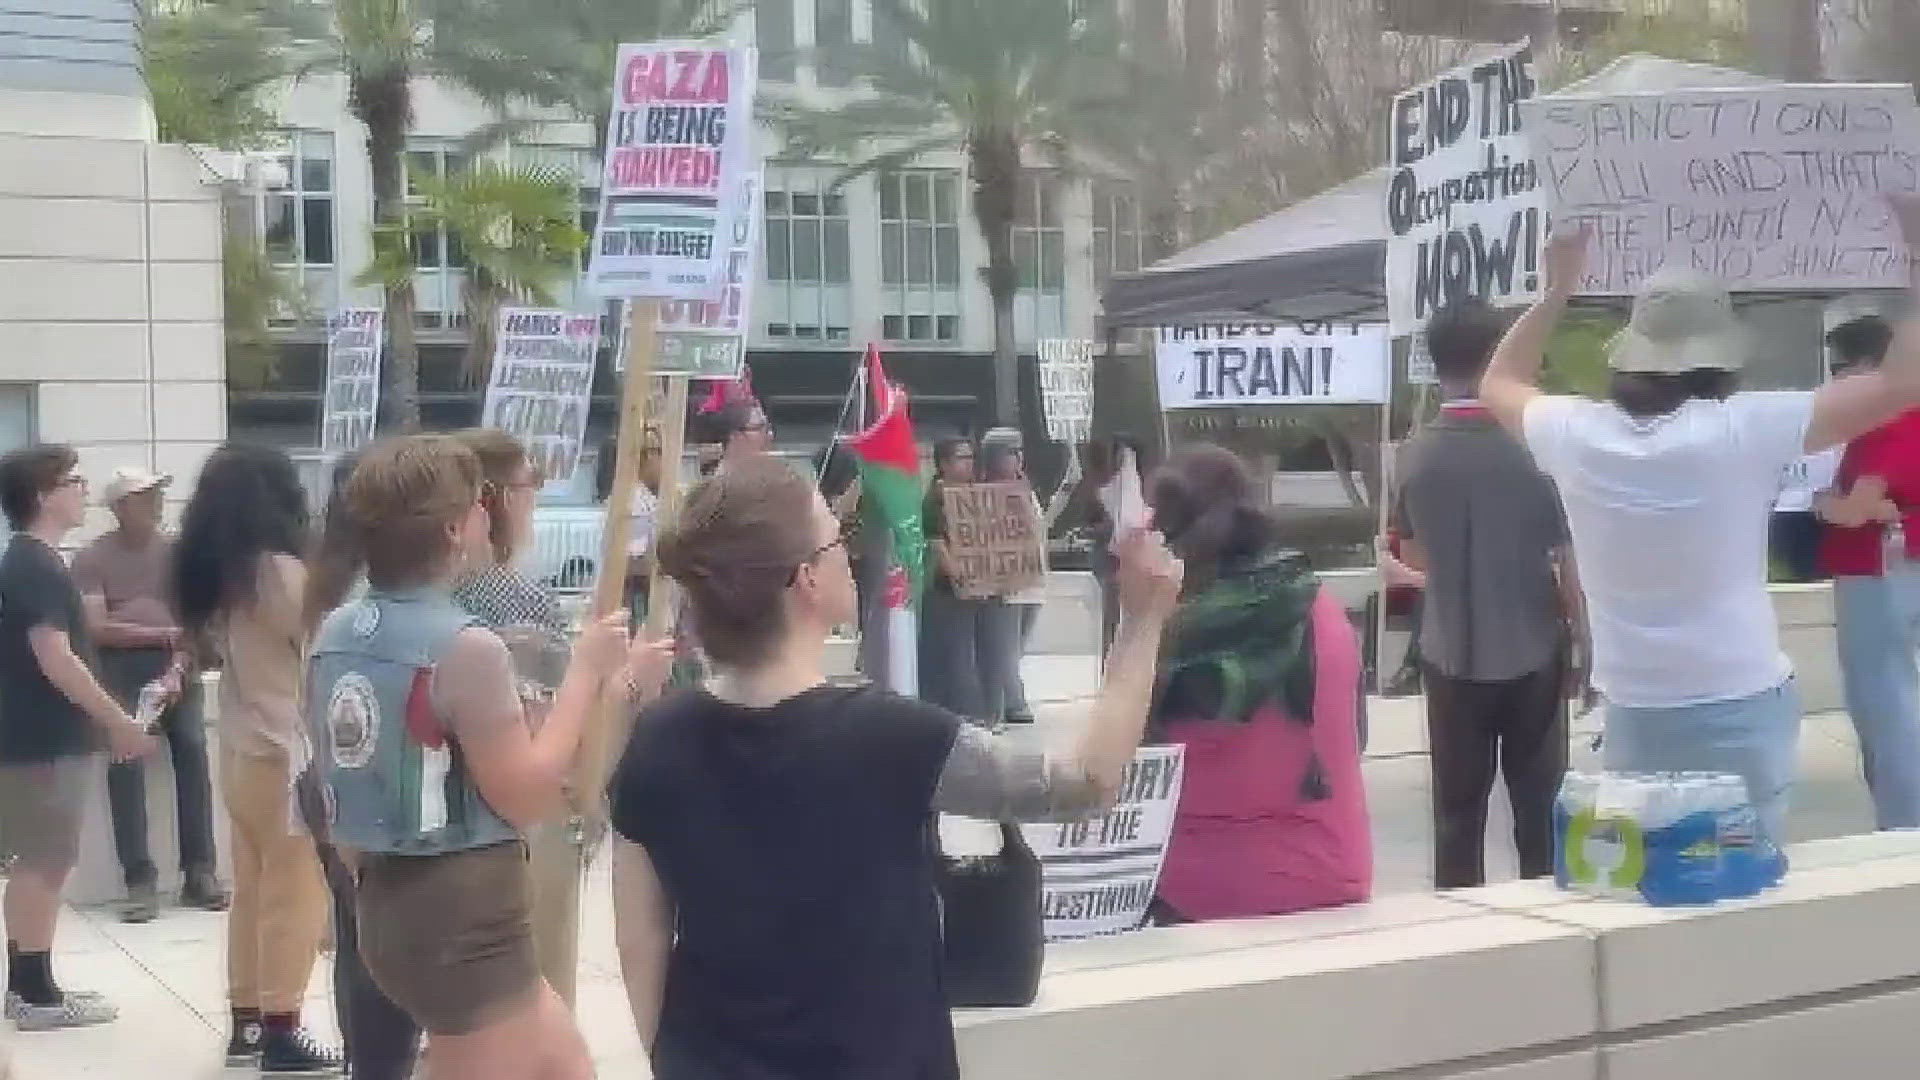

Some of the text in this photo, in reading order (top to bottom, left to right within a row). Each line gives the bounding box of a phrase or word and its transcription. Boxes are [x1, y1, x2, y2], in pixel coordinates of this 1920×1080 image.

[622, 51, 728, 104] GAZA
[648, 107, 727, 147] BEING
[1396, 79, 1470, 164] END
[1546, 99, 1893, 150] SANCTIONS
[1686, 151, 1786, 196] AND
[1416, 207, 1538, 319] NOW!
[1195, 346, 1334, 399] IRAN!
